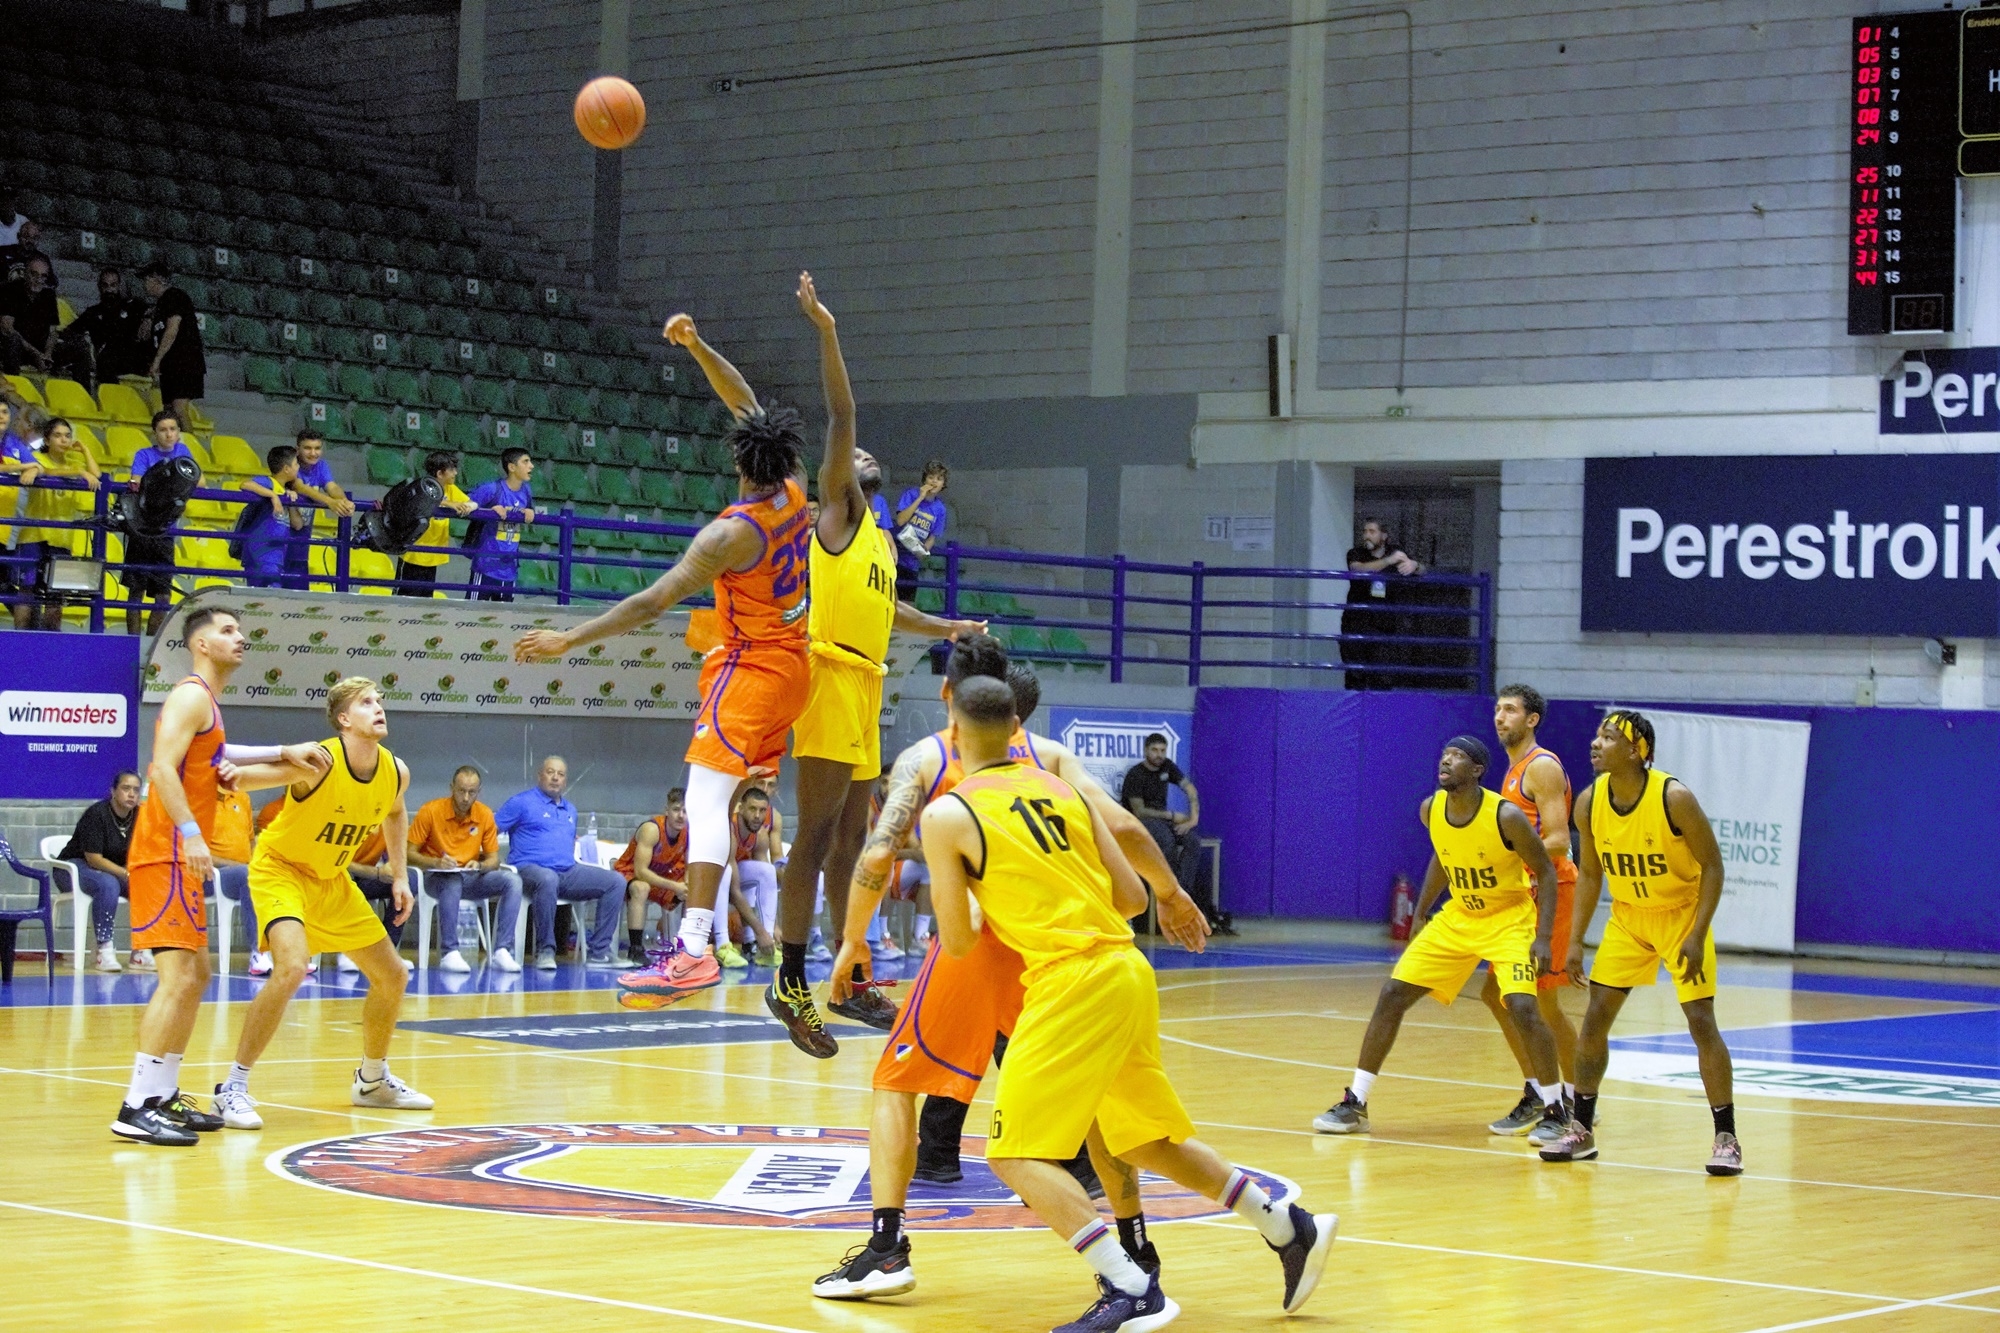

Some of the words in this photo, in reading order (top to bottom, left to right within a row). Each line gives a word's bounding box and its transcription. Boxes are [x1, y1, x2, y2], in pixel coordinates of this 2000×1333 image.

[1859, 27, 1881, 43] 01
[1890, 27, 1899, 38] 4
[1859, 47, 1880, 63] 05
[1890, 47, 1899, 59] 5
[1858, 67, 1880, 84] 03
[1890, 67, 1900, 80] 6
[1989, 69, 2000, 92] H
[1858, 88, 1880, 104] 07
[1890, 88, 1900, 101] 7
[1858, 108, 1880, 125] 08
[1890, 109, 1899, 122] 8
[1857, 129, 1879, 145] 24
[1889, 131, 1899, 143] 9
[1857, 167, 1878, 183] 25
[1885, 165, 1901, 177] 10
[1862, 189, 1878, 202] 11
[1885, 187, 1900, 199] 11
[1856, 209, 1878, 224] 22
[1885, 208, 1901, 220] 12
[1855, 229, 1878, 245] 27
[1885, 229, 1901, 241] 13
[1856, 250, 1877, 266] 31
[1884, 249, 1900, 261] 14
[1856, 272, 1877, 285] 44
[1884, 271, 1900, 283] 15
[1894, 361, 2000, 418] Per
[281, 611, 333, 620] cytavision
[340, 614, 391, 624] cytavision
[398, 617, 448, 626] cytavision
[455, 620, 504, 629] cytavision
[288, 643, 339, 656] cytavision
[346, 646, 397, 658] cytavision
[404, 649, 453, 661] cytavision
[460, 651, 509, 664] cytavision
[568, 656, 614, 669] cytavision
[620, 658, 667, 671] cytavision
[246, 684, 298, 698] cytavision
[420, 690, 469, 705] cytavision
[476, 692, 524, 707] cytavision
[530, 694, 576, 708] cytavision
[582, 696, 628, 710] cytavision
[634, 698, 679, 712] cytavision
[9, 702, 117, 724] winmasters
[1709, 818, 1782, 843] ΤΕΜΗΣ
[1720, 841, 1782, 866] ΕΙΝΟΣ
[1602, 852, 1668, 877] ARIS
[1631, 881, 1649, 898] 11
[1462, 895, 1486, 911] 55
[1513, 963, 1535, 982] 55
[297, 1123, 824, 1167] BASKETBALL
